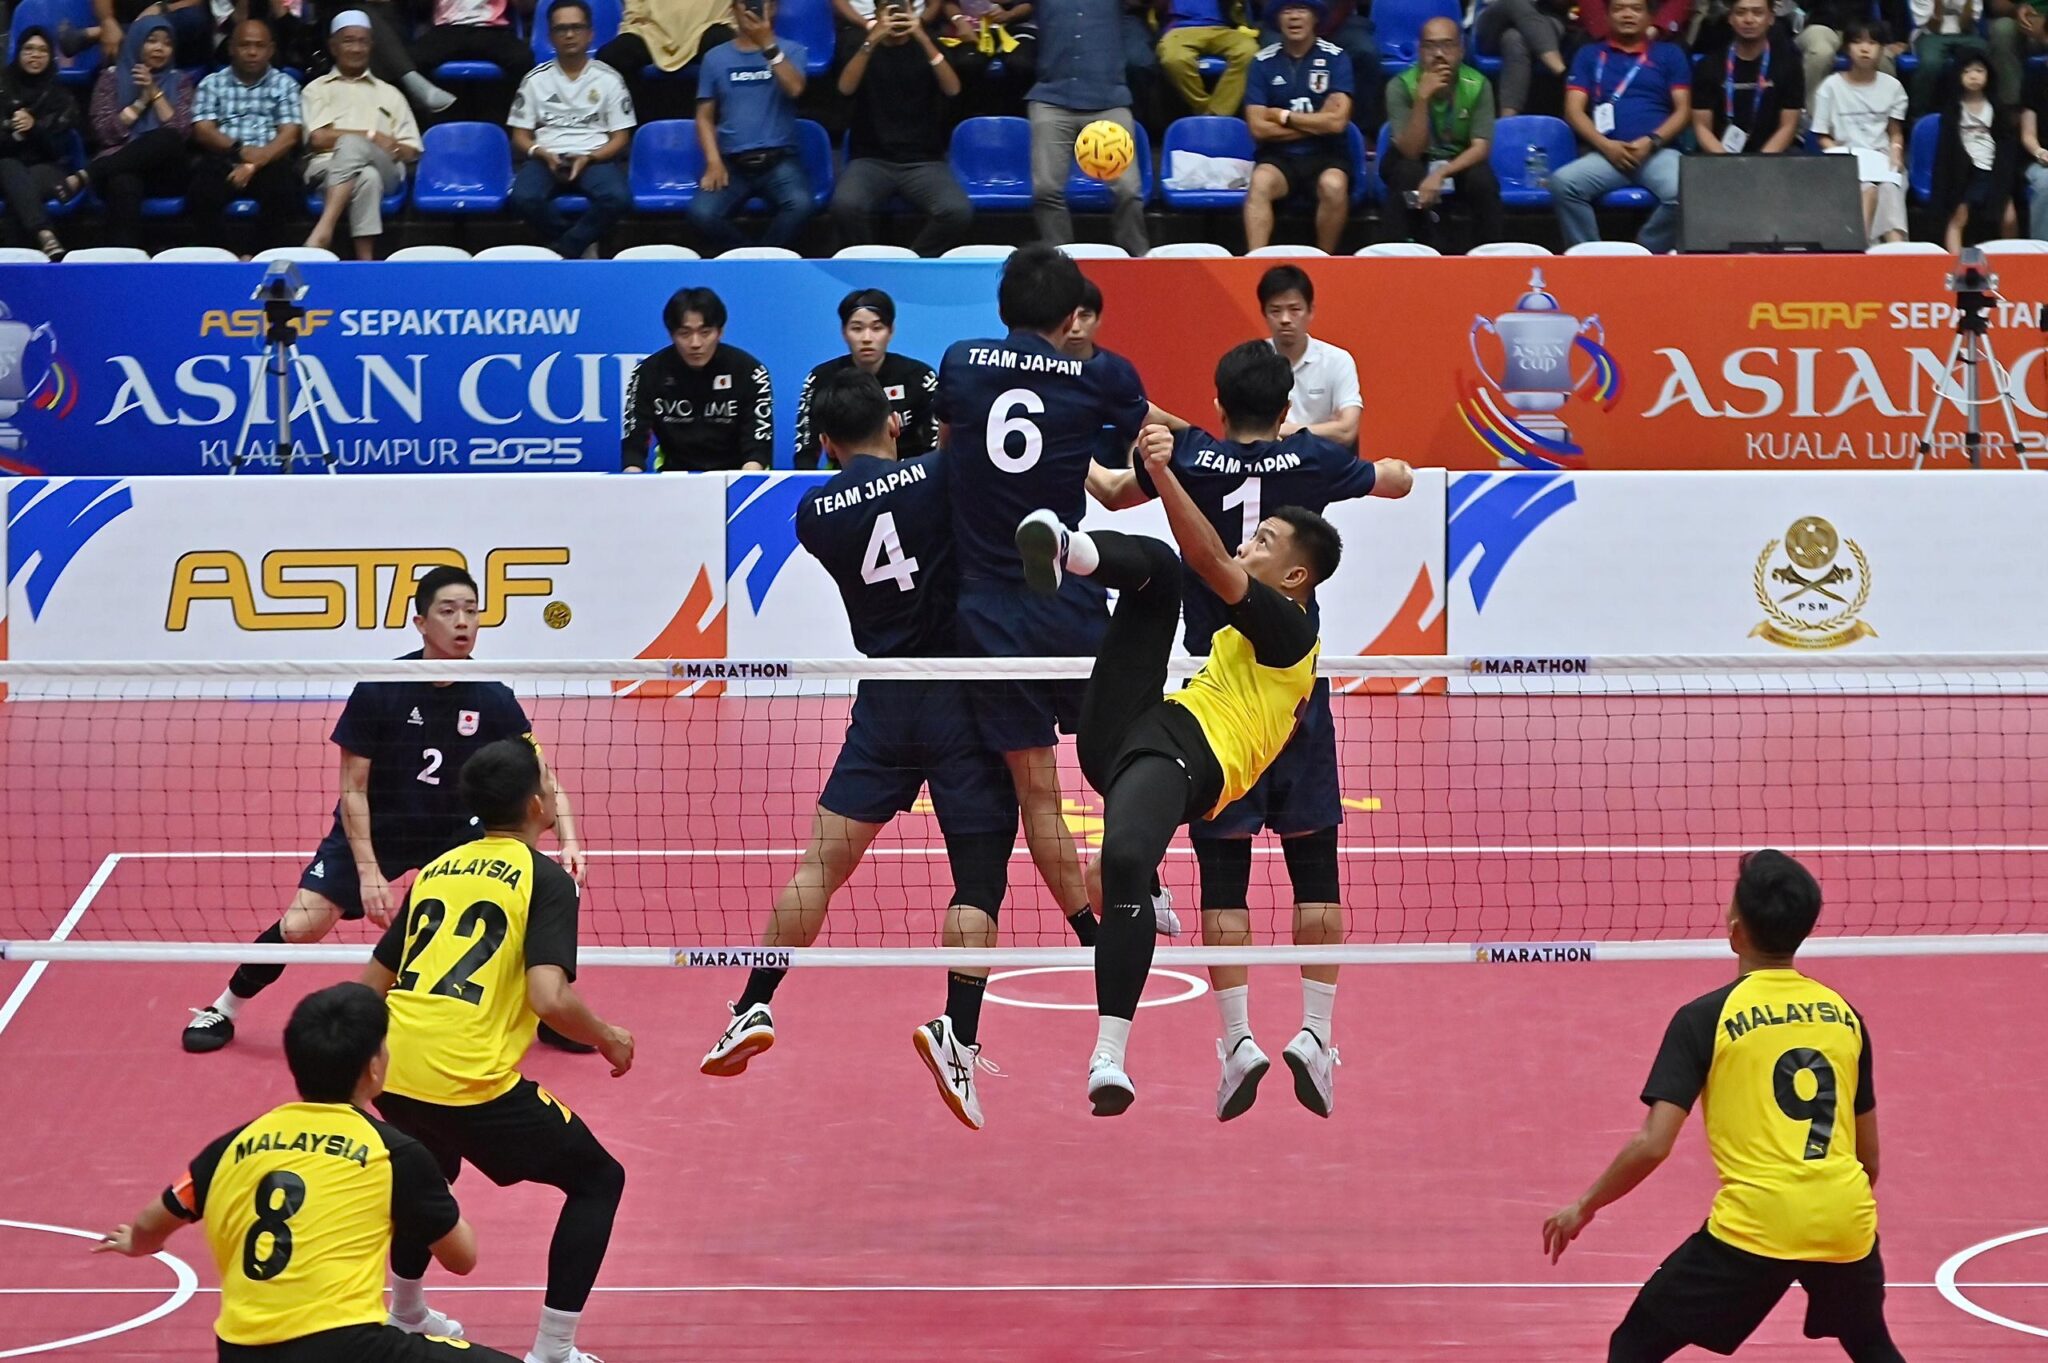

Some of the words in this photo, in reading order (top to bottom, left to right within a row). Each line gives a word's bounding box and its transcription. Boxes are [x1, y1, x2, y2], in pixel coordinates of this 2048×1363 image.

[339, 308, 581, 336] SEPAKTAKRAW
[1748, 302, 1883, 330] ASTAF
[968, 348, 1018, 369] TEAM
[1020, 354, 1083, 376] JAPAN
[95, 354, 429, 426] ASIAN
[1640, 346, 1987, 419] ASIAN
[986, 388, 1045, 474] 6
[1745, 432, 1857, 460] KUALA
[468, 436, 583, 466] 2025
[1194, 449, 1241, 474] TEAM
[814, 486, 862, 516] TEAM
[864, 463, 927, 500] JAPAN
[1222, 476, 1262, 546] 1
[860, 511, 920, 592] 4
[687, 663, 788, 678] MARATHON
[1485, 659, 1587, 674] MARATHON
[416, 748, 443, 785] 2
[419, 859, 522, 892] MALAYSIA
[392, 898, 508, 1006] 22
[689, 952, 790, 967] MARATHON
[1491, 947, 1592, 963] MARATHON
[1724, 1002, 1856, 1042] MALAYSIA
[1773, 1047, 1837, 1161] 9
[235, 1131, 369, 1168] MALAYSIA
[243, 1170, 306, 1281] 8
